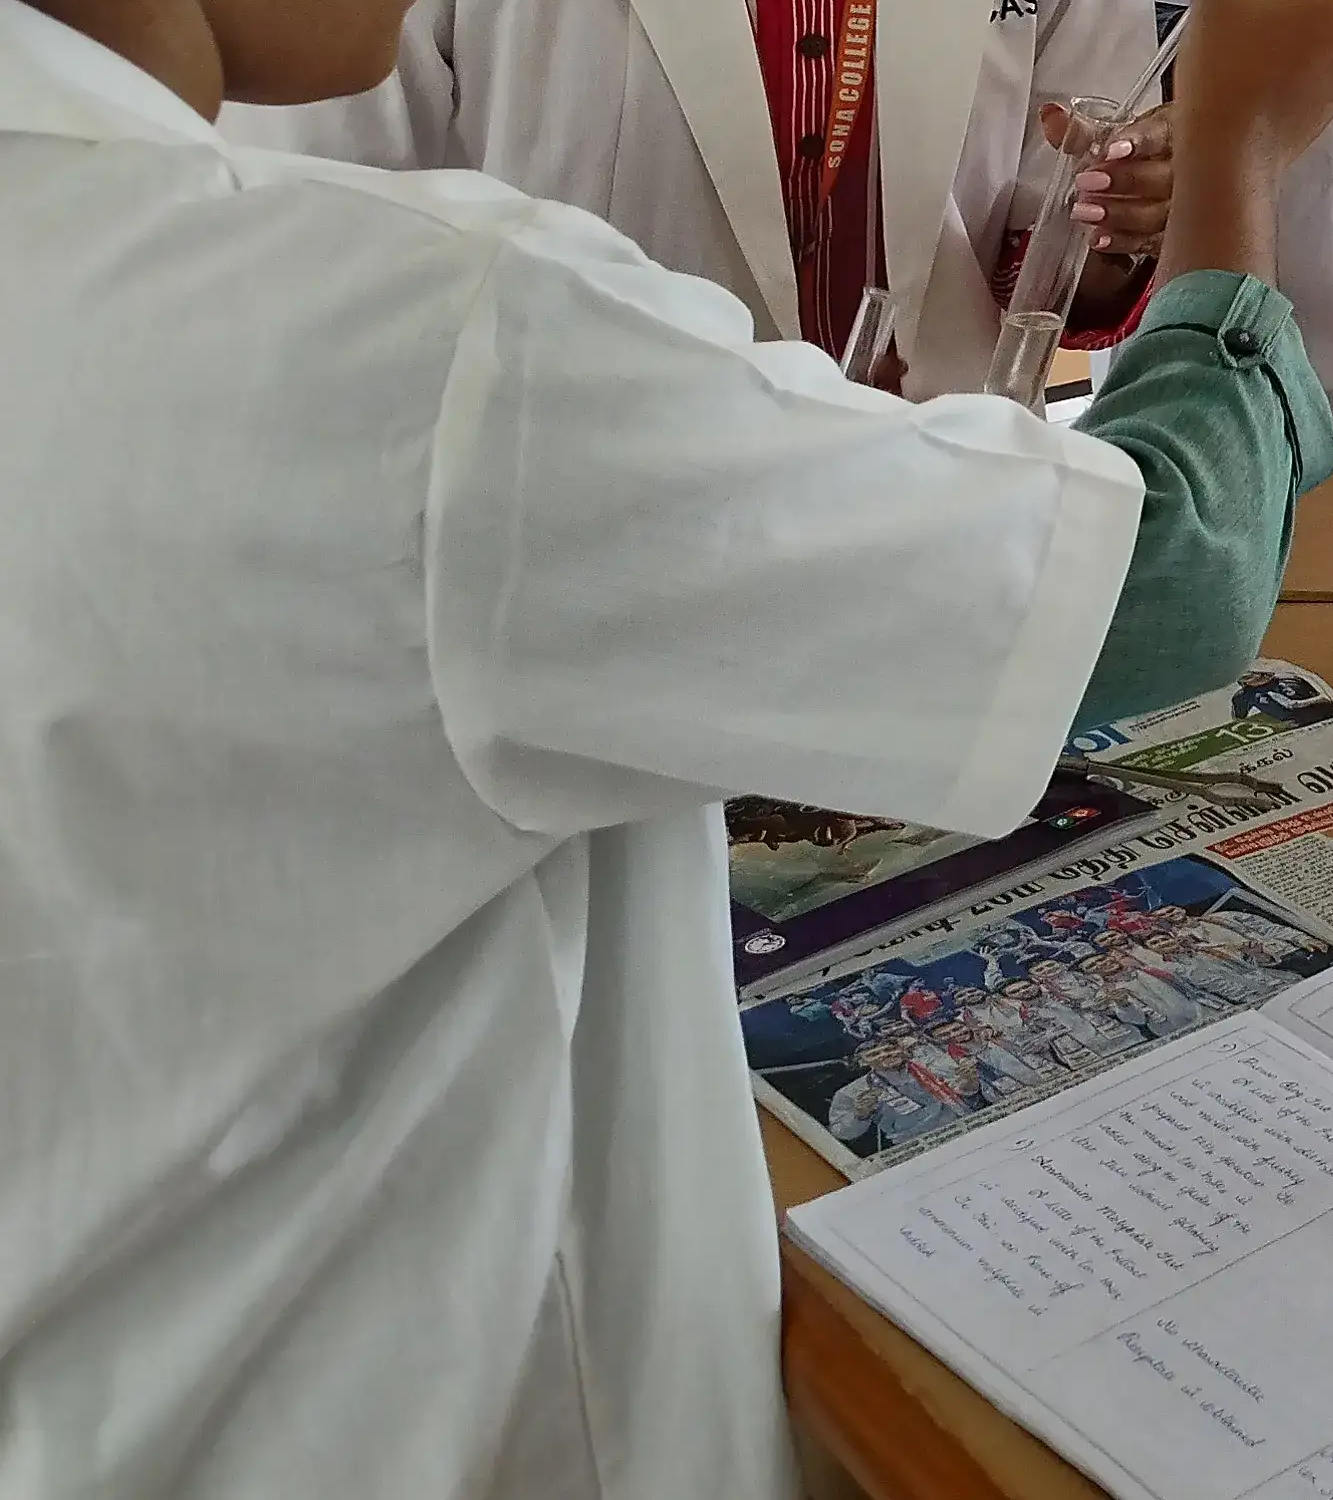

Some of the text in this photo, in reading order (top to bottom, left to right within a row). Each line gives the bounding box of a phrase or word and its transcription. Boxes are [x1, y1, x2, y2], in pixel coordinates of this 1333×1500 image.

[838, 3, 873, 102] COLLEGE
[828, 109, 856, 169] SONA
[1215, 721, 1275, 745] 13
